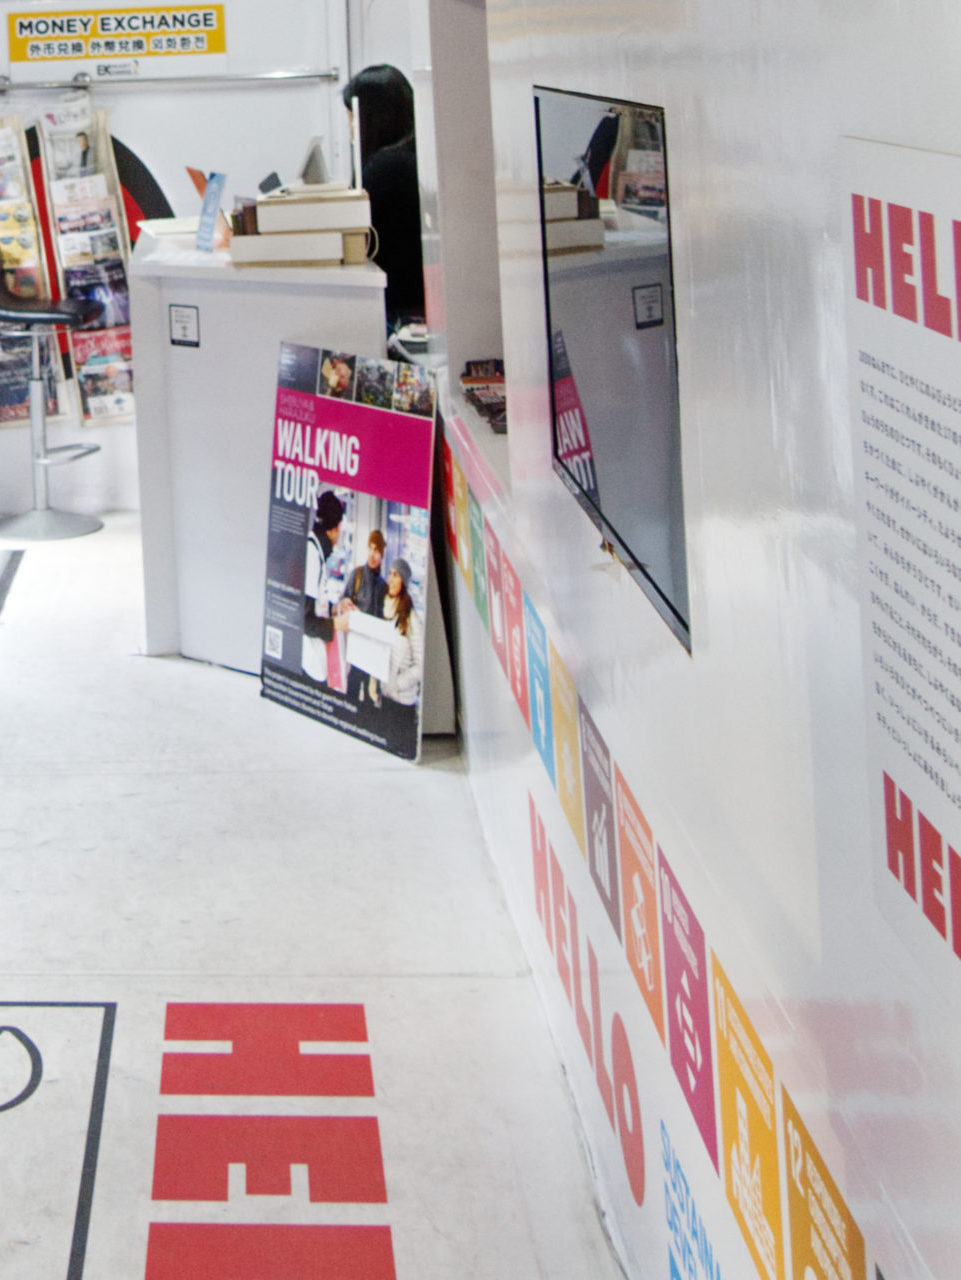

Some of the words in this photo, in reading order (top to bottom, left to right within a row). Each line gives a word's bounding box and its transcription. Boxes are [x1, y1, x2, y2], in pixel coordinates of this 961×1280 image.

[19, 18, 92, 36] MONEY
[100, 12, 215, 32] EXCHANGE
[851, 193, 961, 343] HEL
[274, 459, 320, 510] TOUR
[277, 418, 360, 477] WALKING
[528, 787, 646, 1208] HELLO
[660, 1118, 722, 1280] SUSTAIN
[787, 1117, 805, 1199] 12
